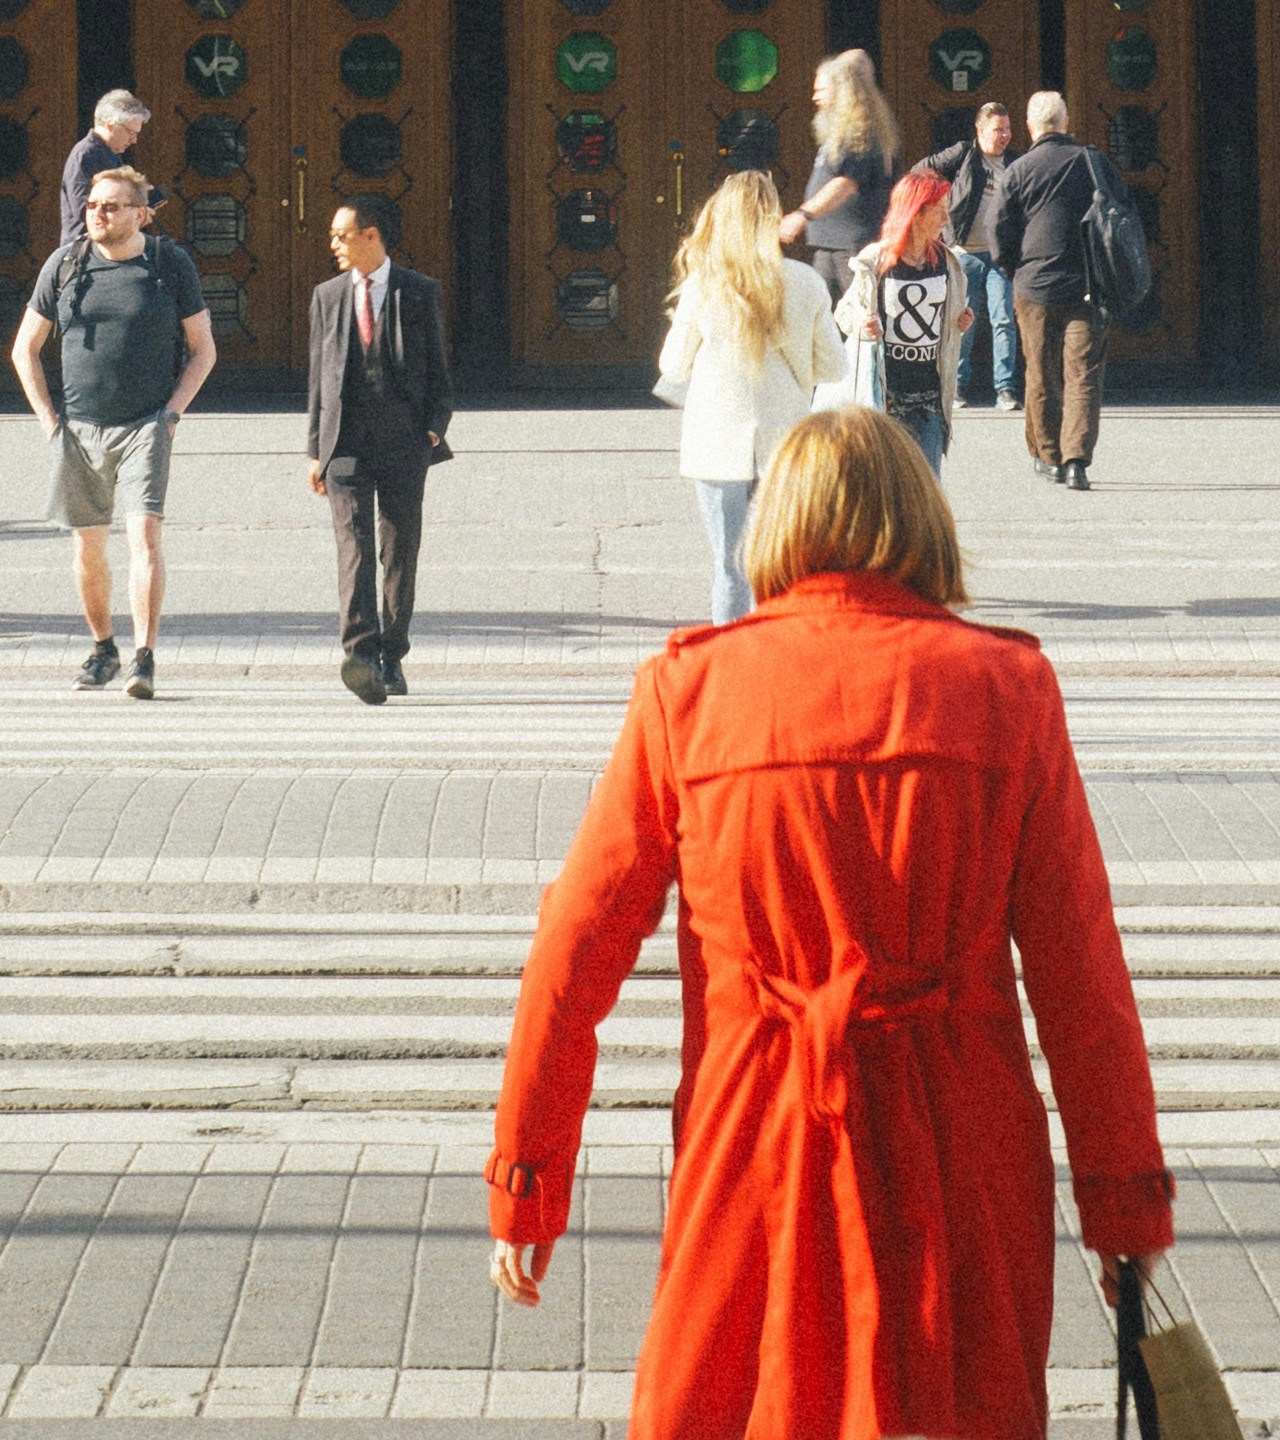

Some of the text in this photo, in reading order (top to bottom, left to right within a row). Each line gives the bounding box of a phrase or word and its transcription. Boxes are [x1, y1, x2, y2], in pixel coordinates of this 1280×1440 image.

[192, 56, 240, 77] VR
[563, 51, 610, 73] VR
[935, 50, 984, 71] VR
[893, 283, 946, 344] &
